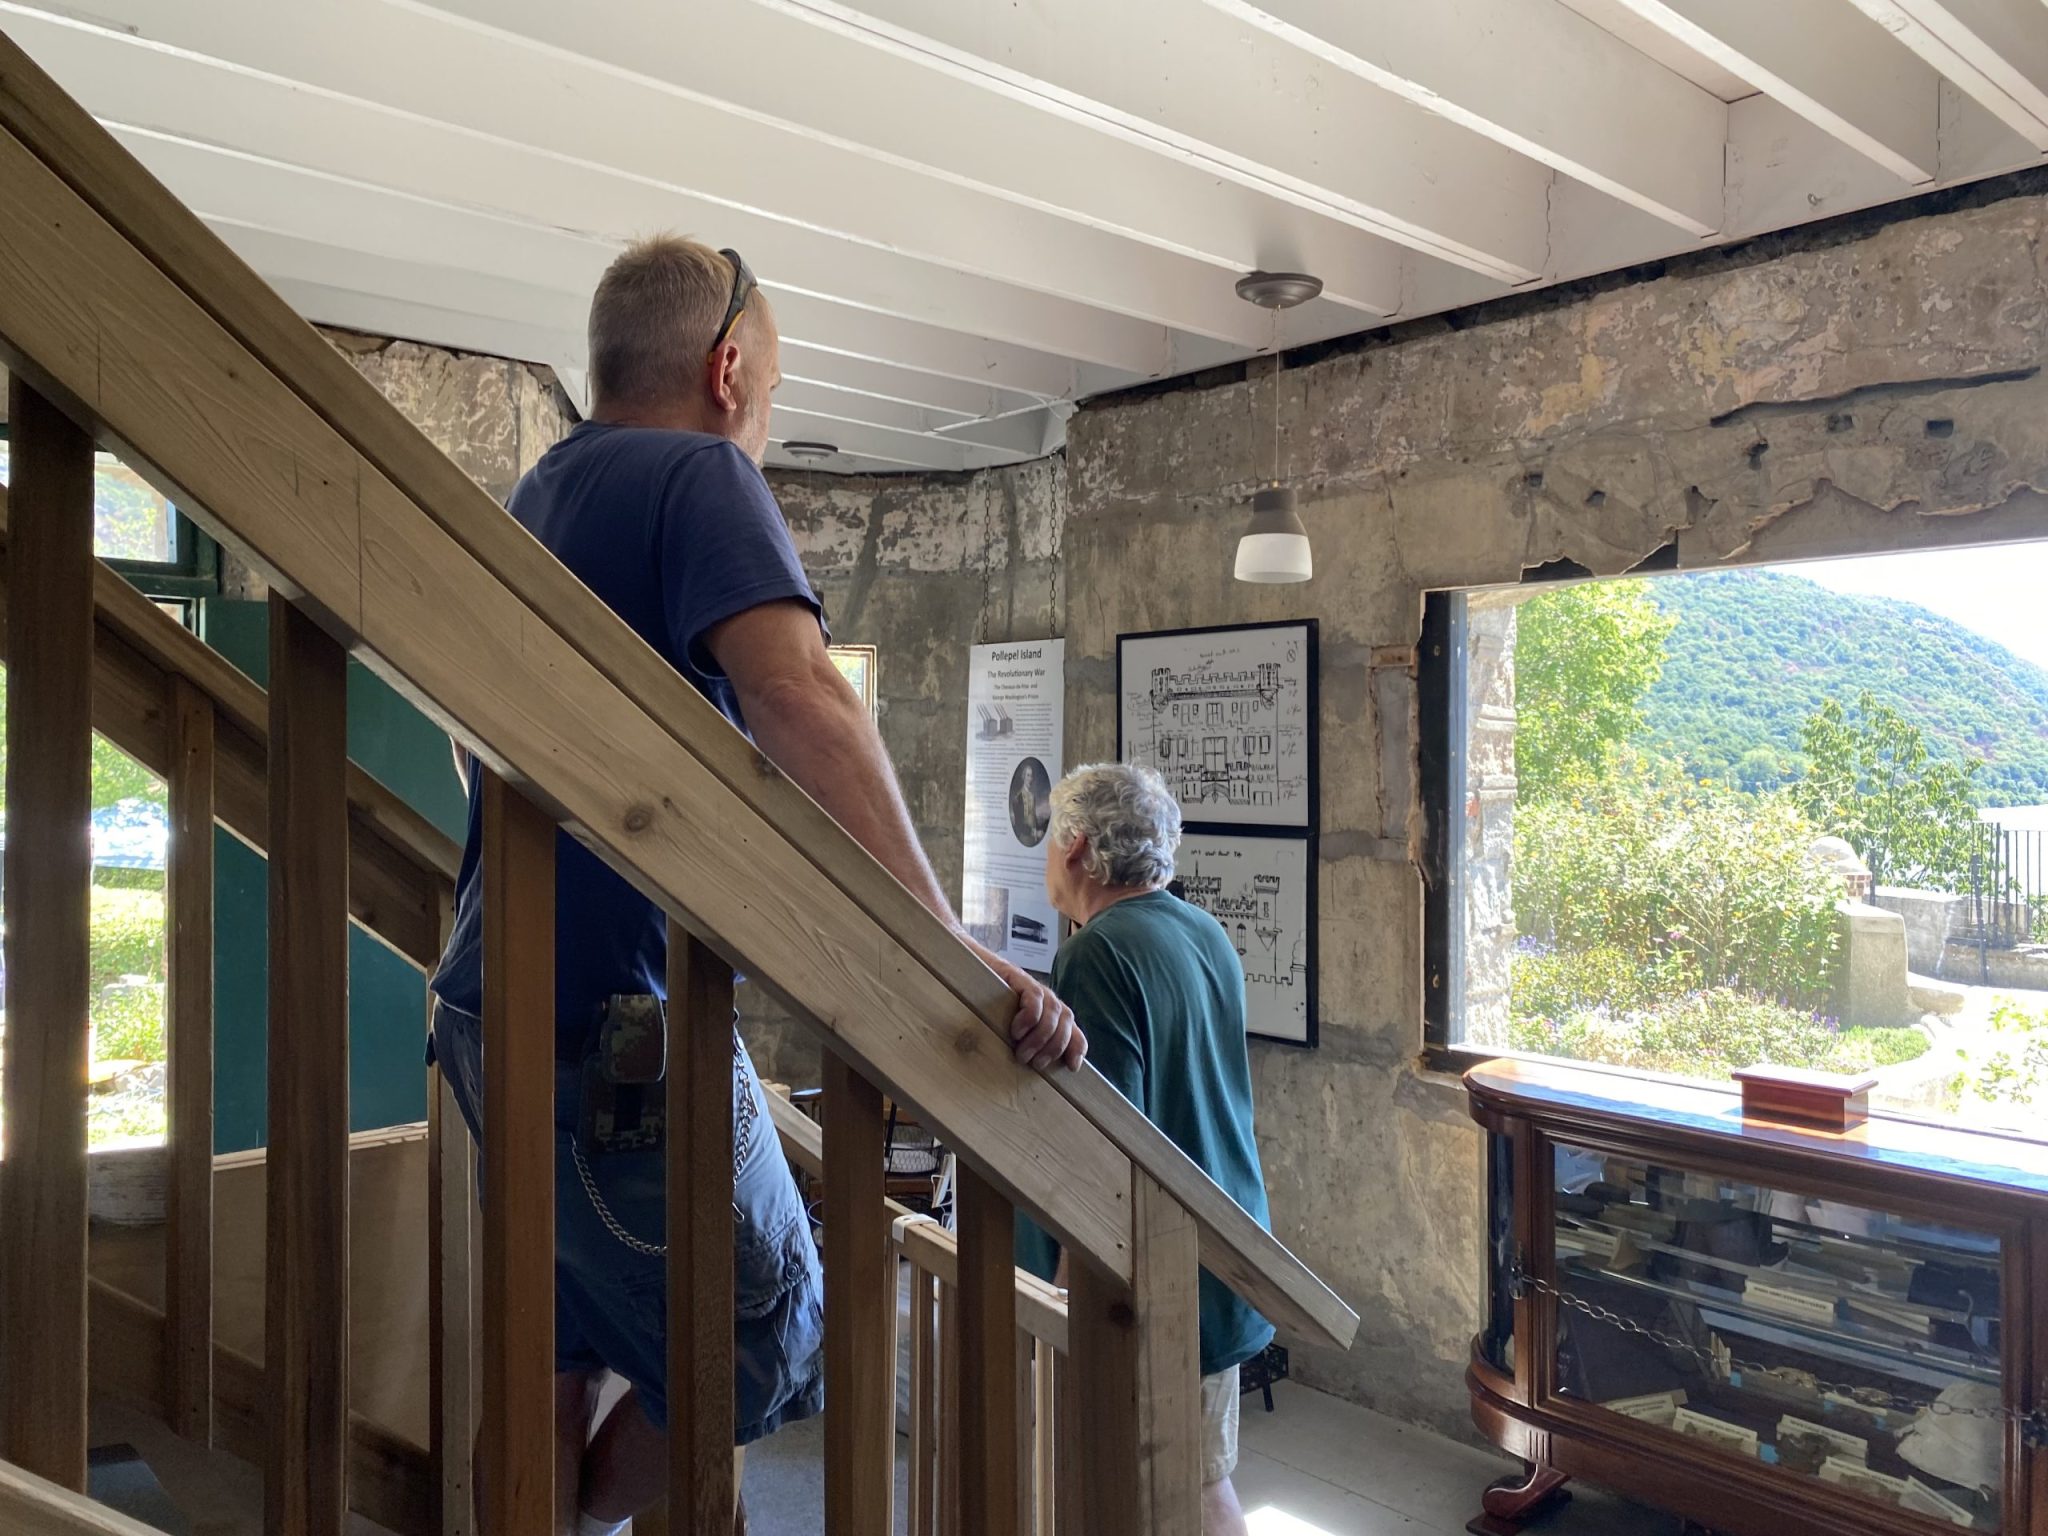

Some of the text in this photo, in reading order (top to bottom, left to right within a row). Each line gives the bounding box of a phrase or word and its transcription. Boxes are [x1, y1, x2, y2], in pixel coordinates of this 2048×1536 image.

[992, 648, 1042, 662] Pollepel Island
[988, 668, 1045, 679] The Revolutionary War
